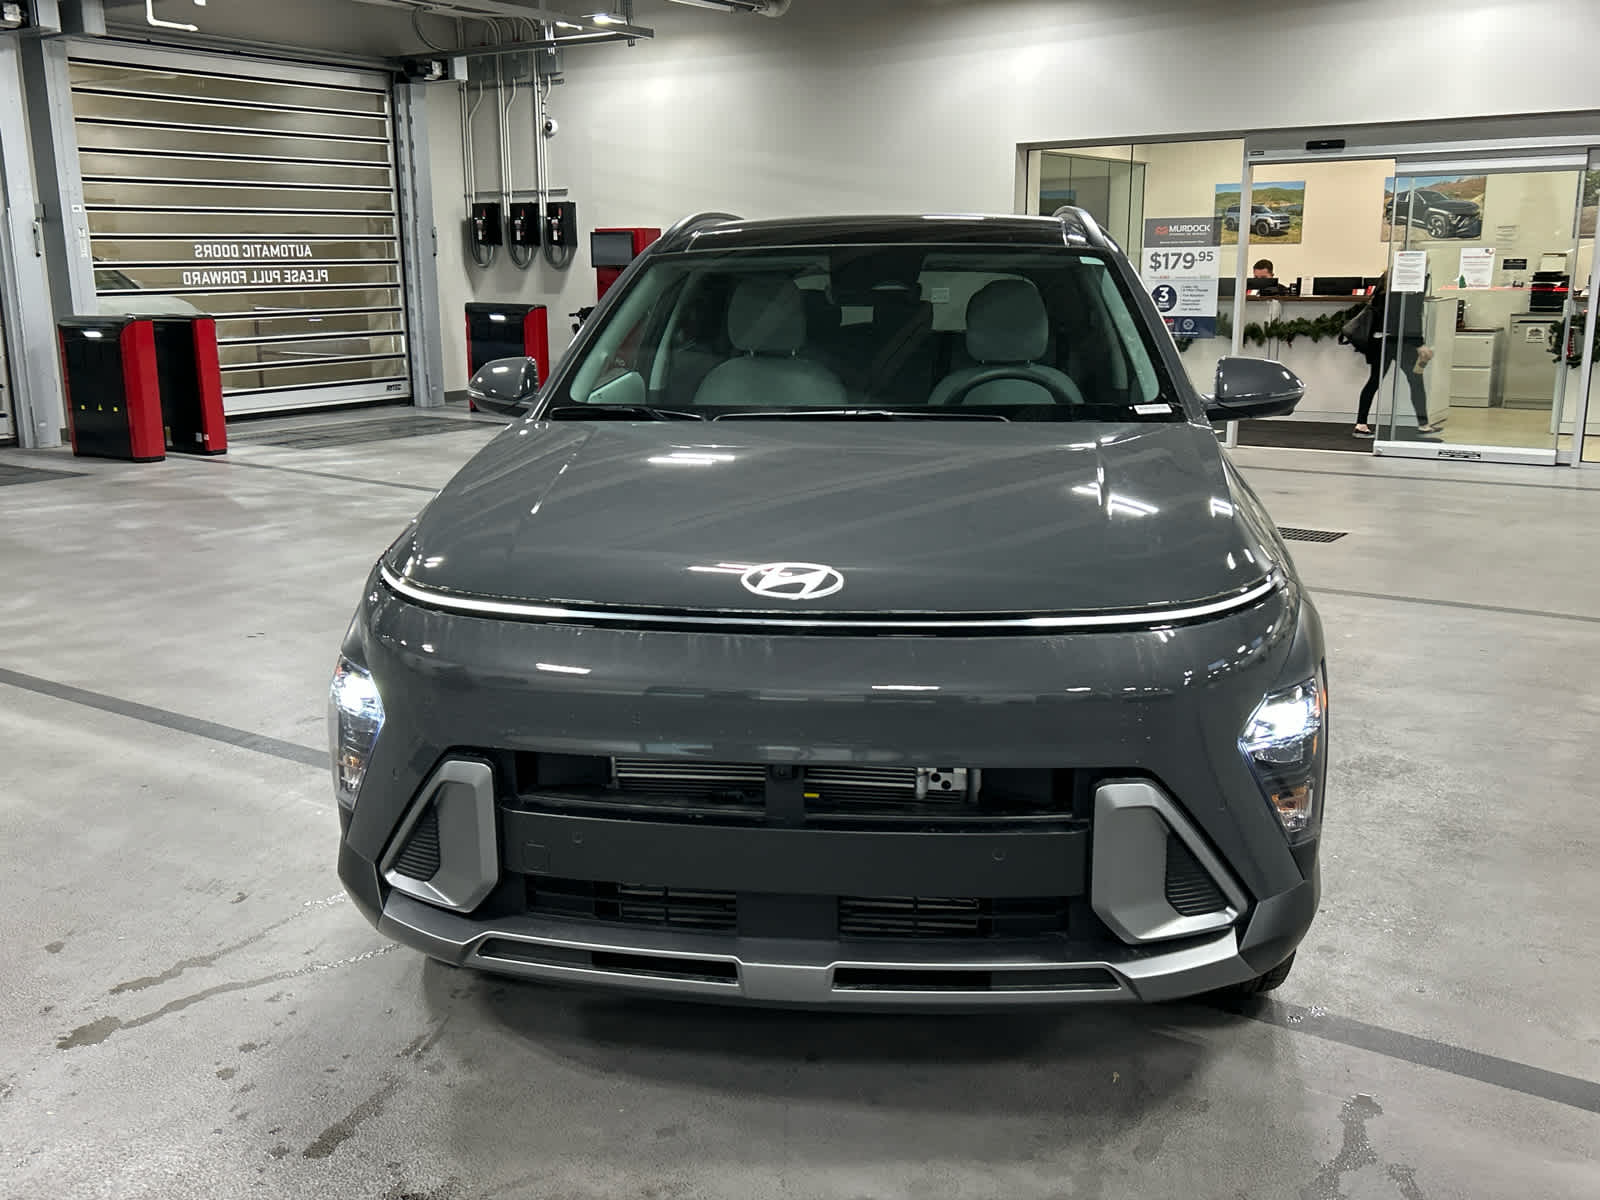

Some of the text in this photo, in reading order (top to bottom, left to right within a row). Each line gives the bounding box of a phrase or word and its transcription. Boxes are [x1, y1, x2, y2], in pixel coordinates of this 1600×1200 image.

[1169, 224, 1211, 233] MURDOCK
[1149, 251, 1214, 272] $179.95
[1158, 287, 1169, 302] 3
